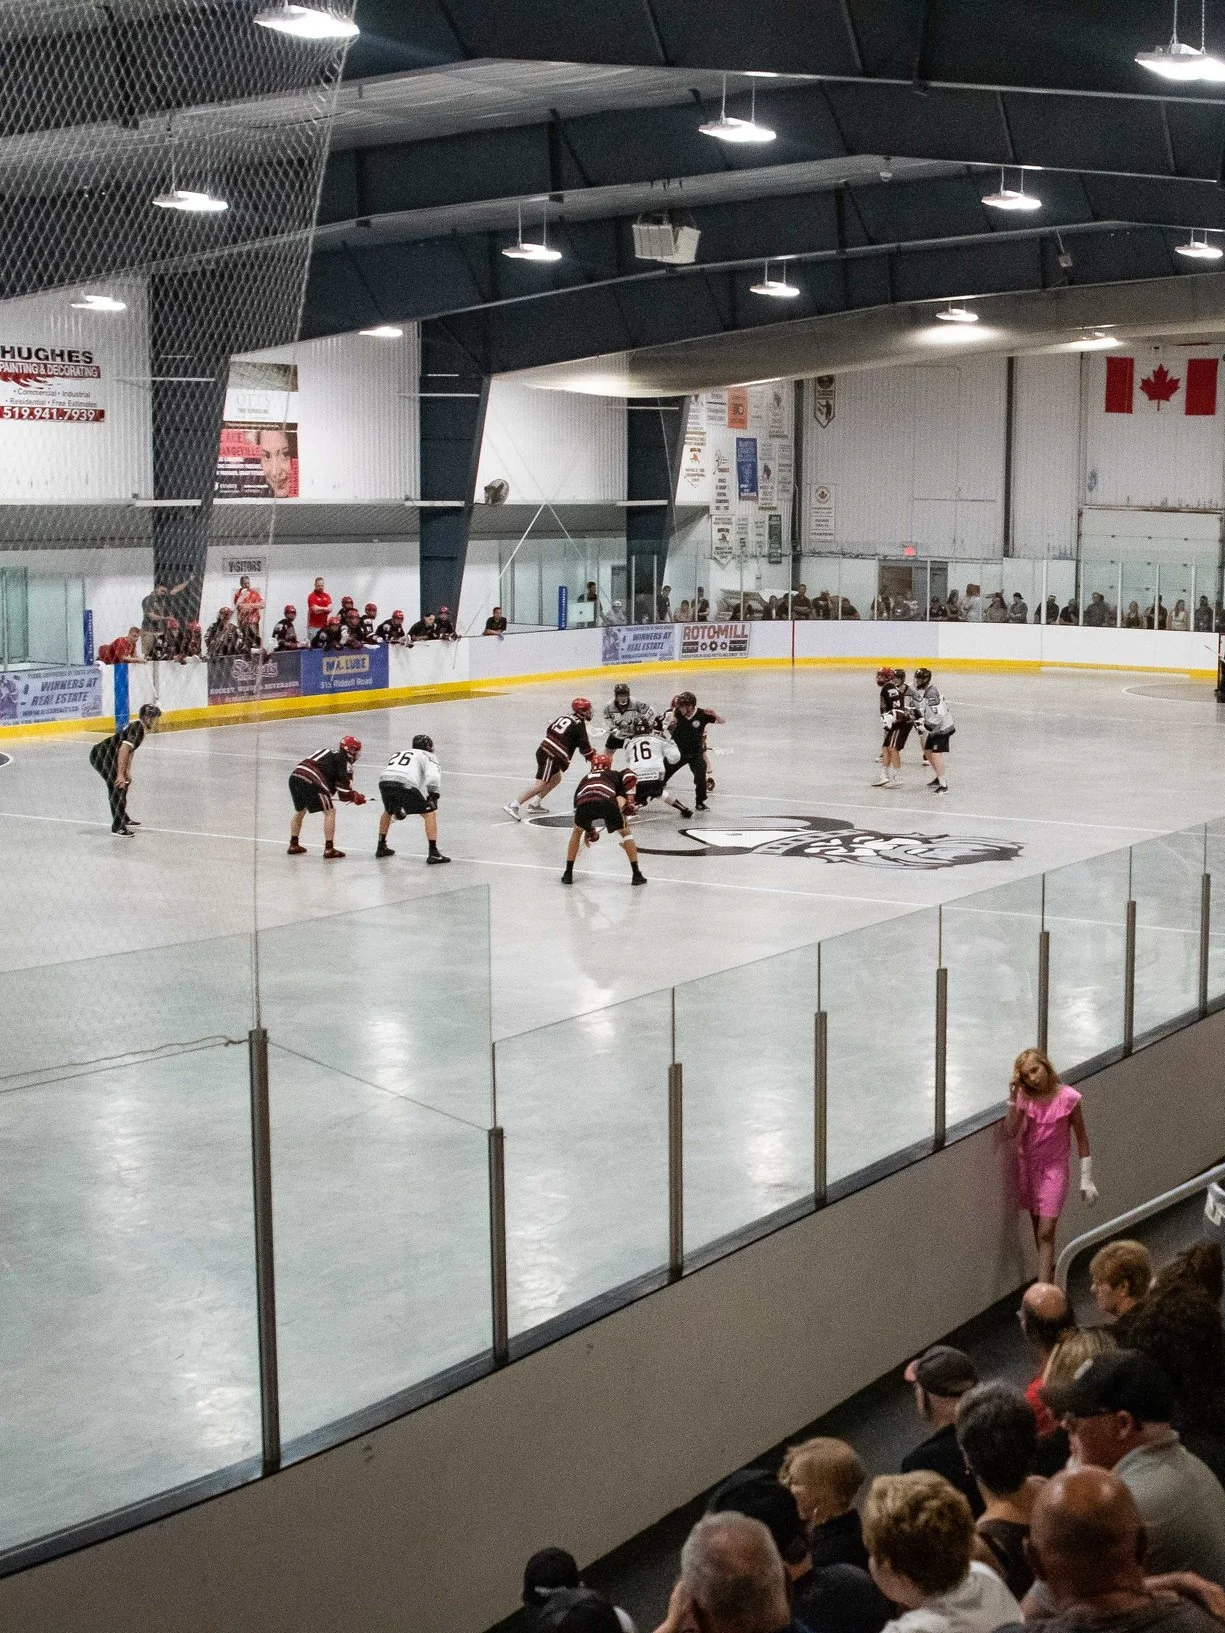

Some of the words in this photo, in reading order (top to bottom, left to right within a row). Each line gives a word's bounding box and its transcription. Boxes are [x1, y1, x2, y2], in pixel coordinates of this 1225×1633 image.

[0, 345, 94, 364] HUGHES
[0, 361, 38, 374] PAINTING
[39, 363, 45, 375] &
[46, 364, 98, 377] DECORATING
[17, 388, 56, 397] Commercial
[62, 390, 90, 398] Industrial
[52, 399, 66, 407] Free
[3, 406, 96, 421] 519.941.7939
[632, 632, 663, 641] WINNERS
[662, 631, 672, 639] AT
[626, 643, 642, 652] REAL
[642, 641, 665, 651] ESTATE
[346, 657, 367, 670] LUBE
[41, 679, 85, 692] WINNERS
[86, 677, 99, 689] AT
[356, 677, 373, 686] Road
[31, 695, 53, 706] REAL
[55, 692, 90, 704] ESTATE
[551, 716, 572, 734] 19
[388, 751, 414, 767] 26
[632, 741, 651, 763] 16
